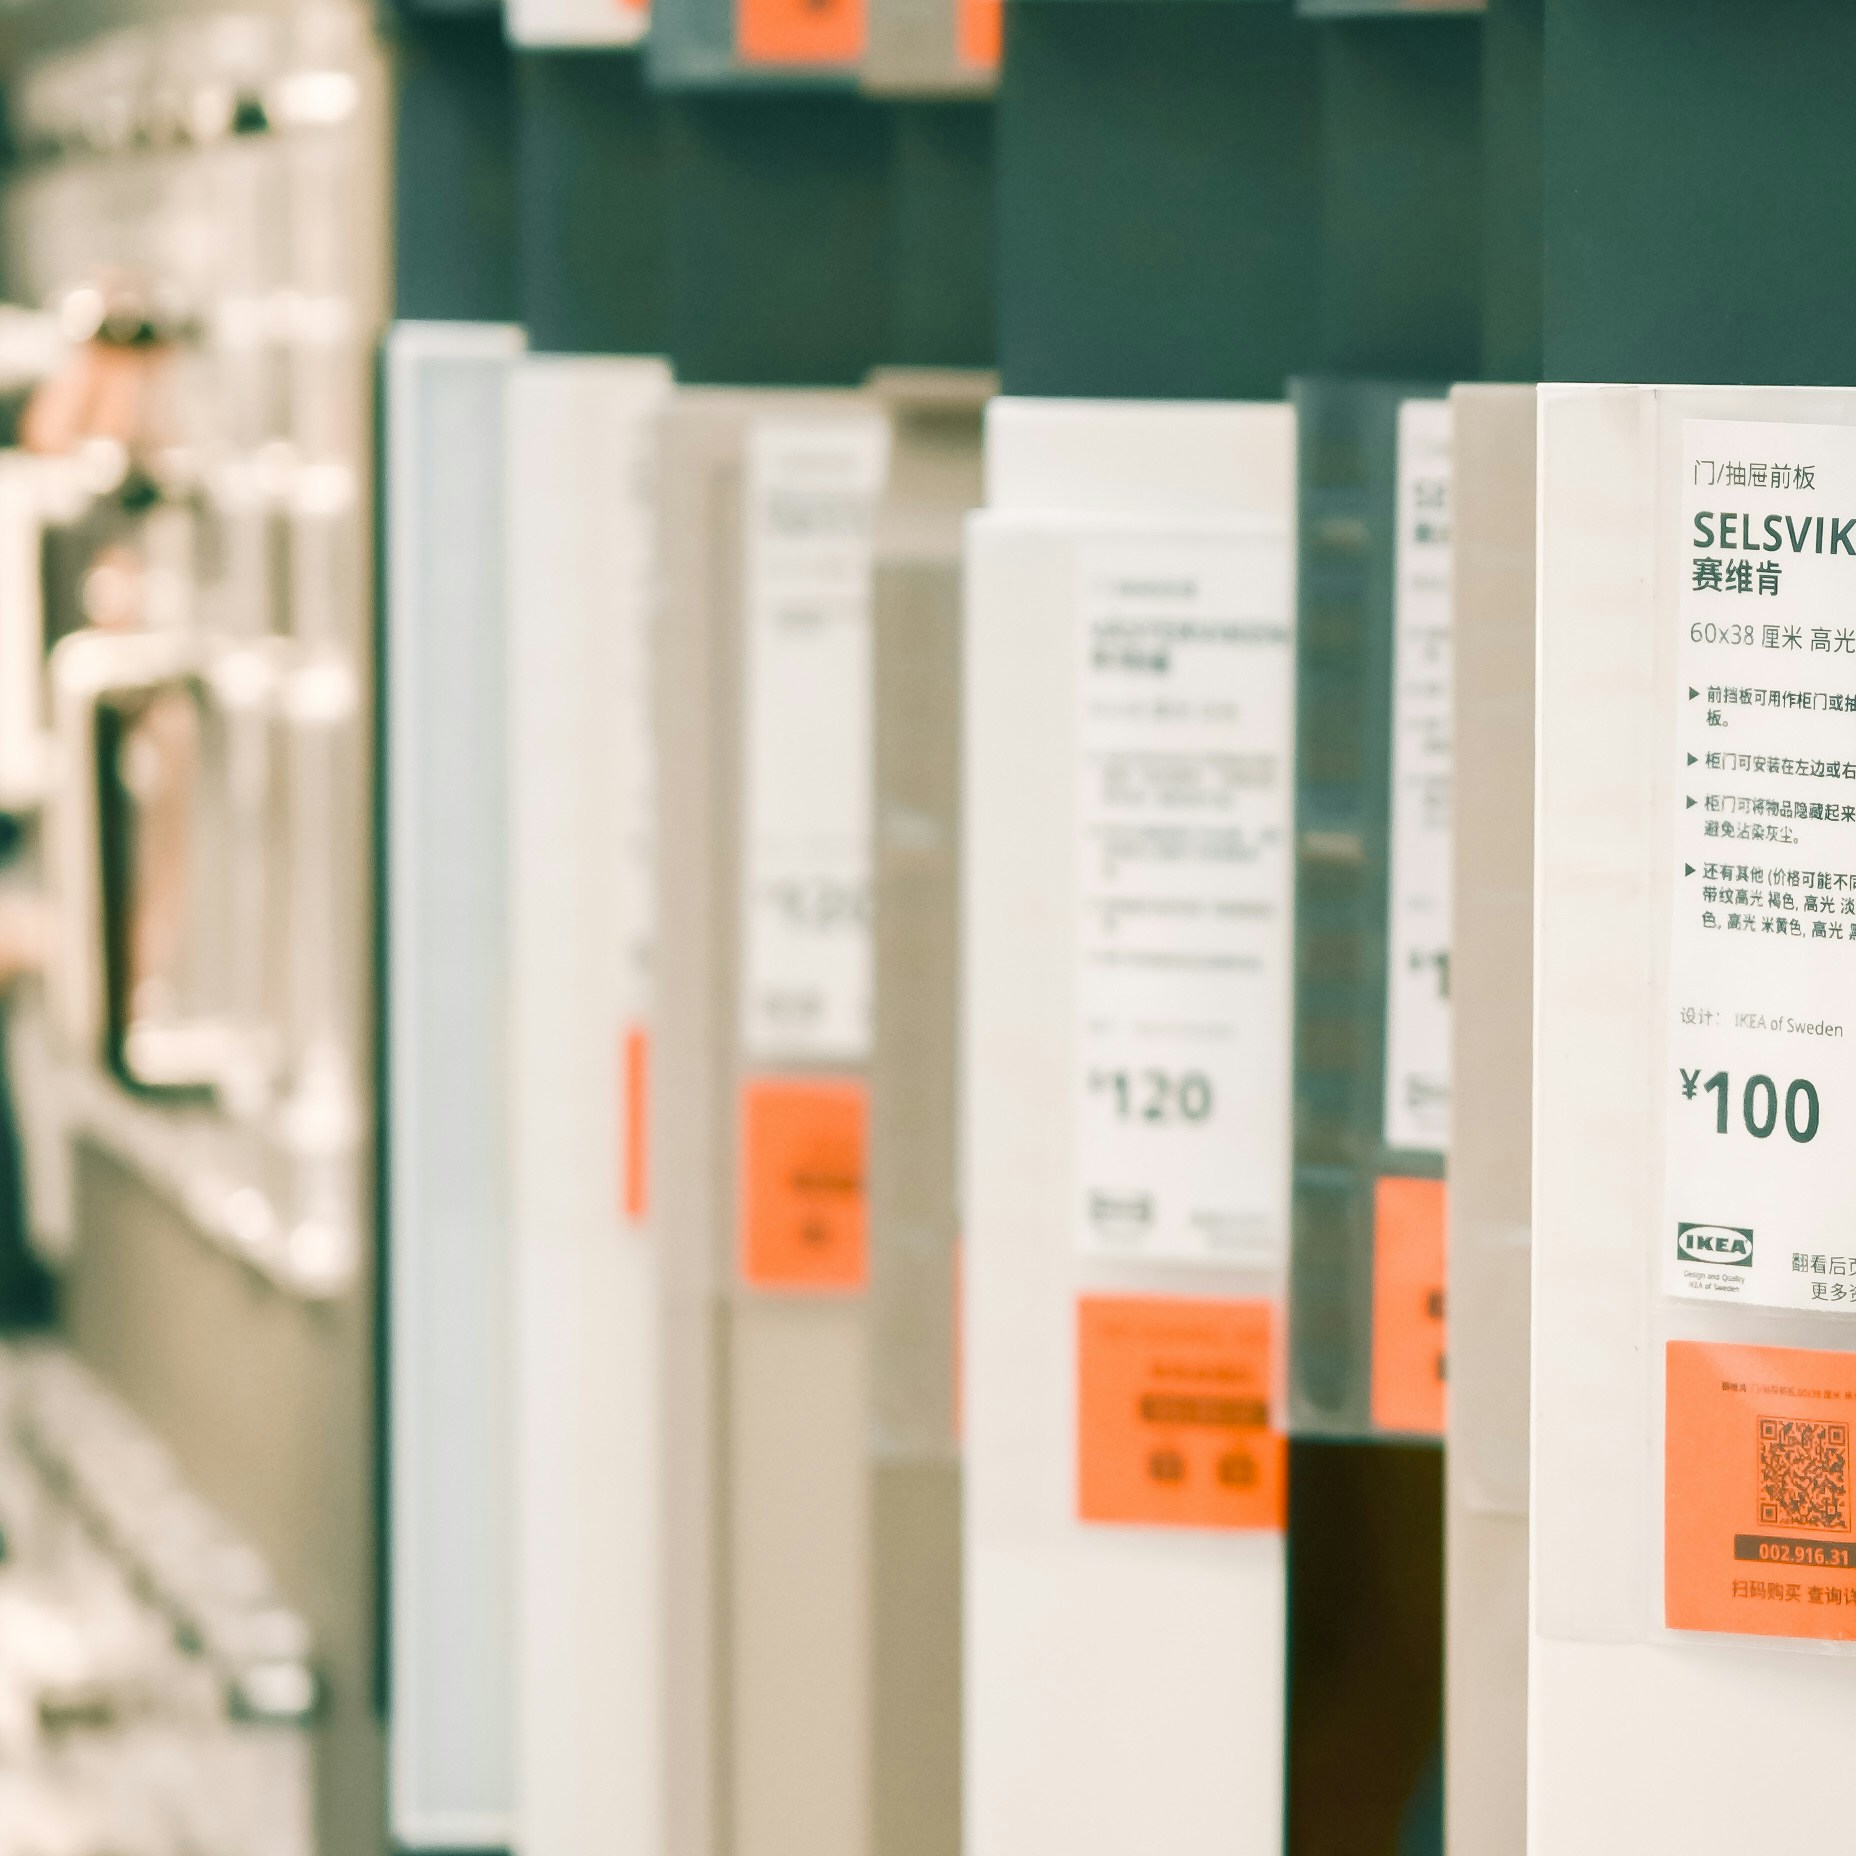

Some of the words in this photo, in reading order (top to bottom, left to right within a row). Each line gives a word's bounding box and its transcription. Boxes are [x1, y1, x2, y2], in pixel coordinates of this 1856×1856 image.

[1693, 459, 1817, 490] 门/抽屉前板
[1692, 557, 1782, 596] 赛维肯
[1690, 622, 1754, 645] 60x38
[1762, 624, 1802, 650] 厘米
[1810, 627, 1856, 654] 高光
[1706, 708, 1728, 727] 板。
[1704, 819, 1799, 844] 避免沾染灰尘。
[1702, 862, 1763, 884] 还有其他
[1702, 885, 1763, 907] 带纹高光
[1803, 895, 1835, 914] 高光
[1727, 913, 1756, 932] 高光
[1811, 920, 1843, 940] 高光
[1735, 1012, 1767, 1029] IKEA
[1770, 1016, 1784, 1031] of
[1786, 1018, 1843, 1037] Sweden
[1679, 1067, 1820, 1144] ¥100
[1685, 1234, 1747, 1255] IKEA
[1759, 1543, 1849, 1565] 002.916.31
[1731, 1578, 1802, 1603] 扫码购买
